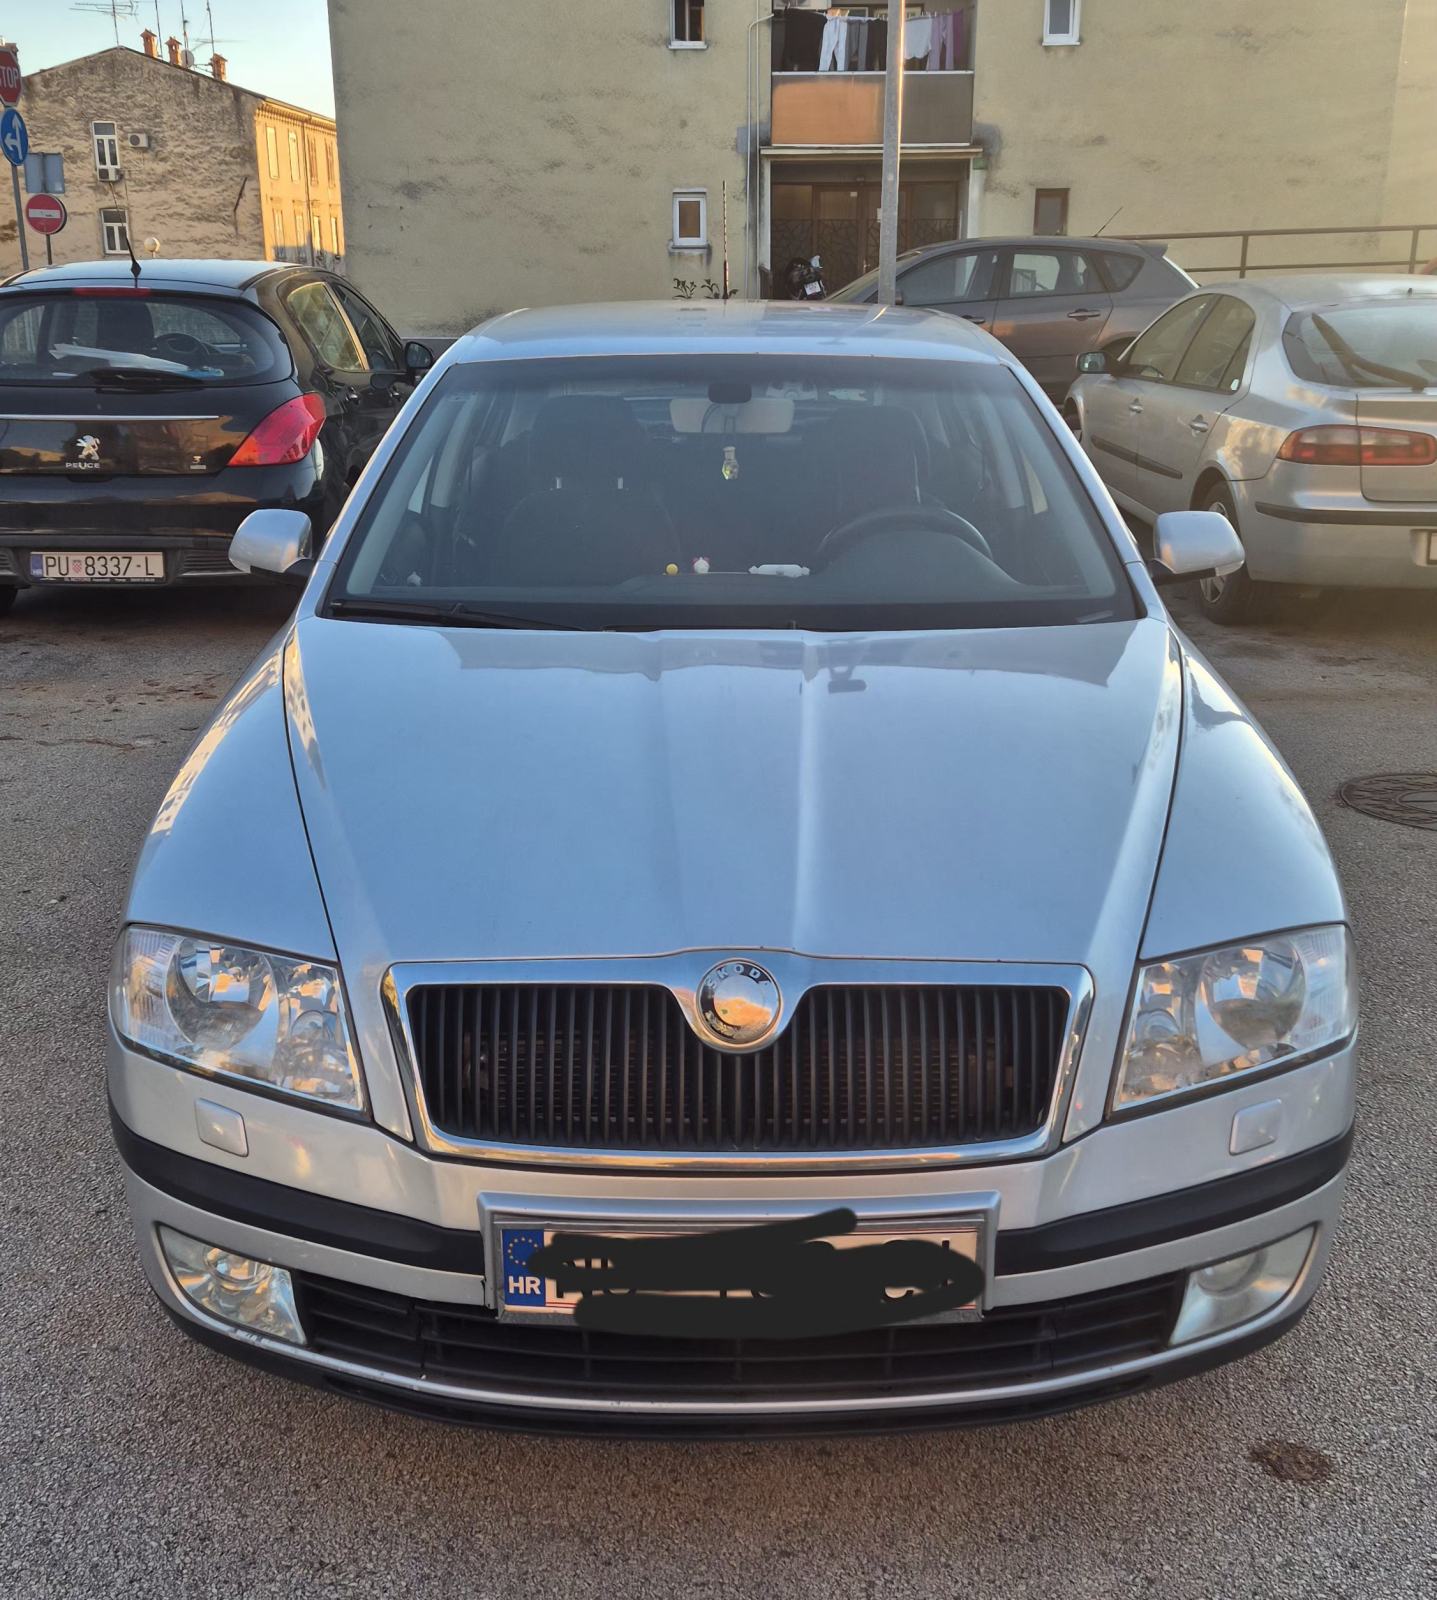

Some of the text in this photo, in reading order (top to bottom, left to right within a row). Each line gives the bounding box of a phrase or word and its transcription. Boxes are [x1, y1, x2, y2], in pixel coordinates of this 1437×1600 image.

[0, 65, 19, 88] TOP
[45, 556, 69, 576] PU
[508, 1276, 541, 1294] HR
